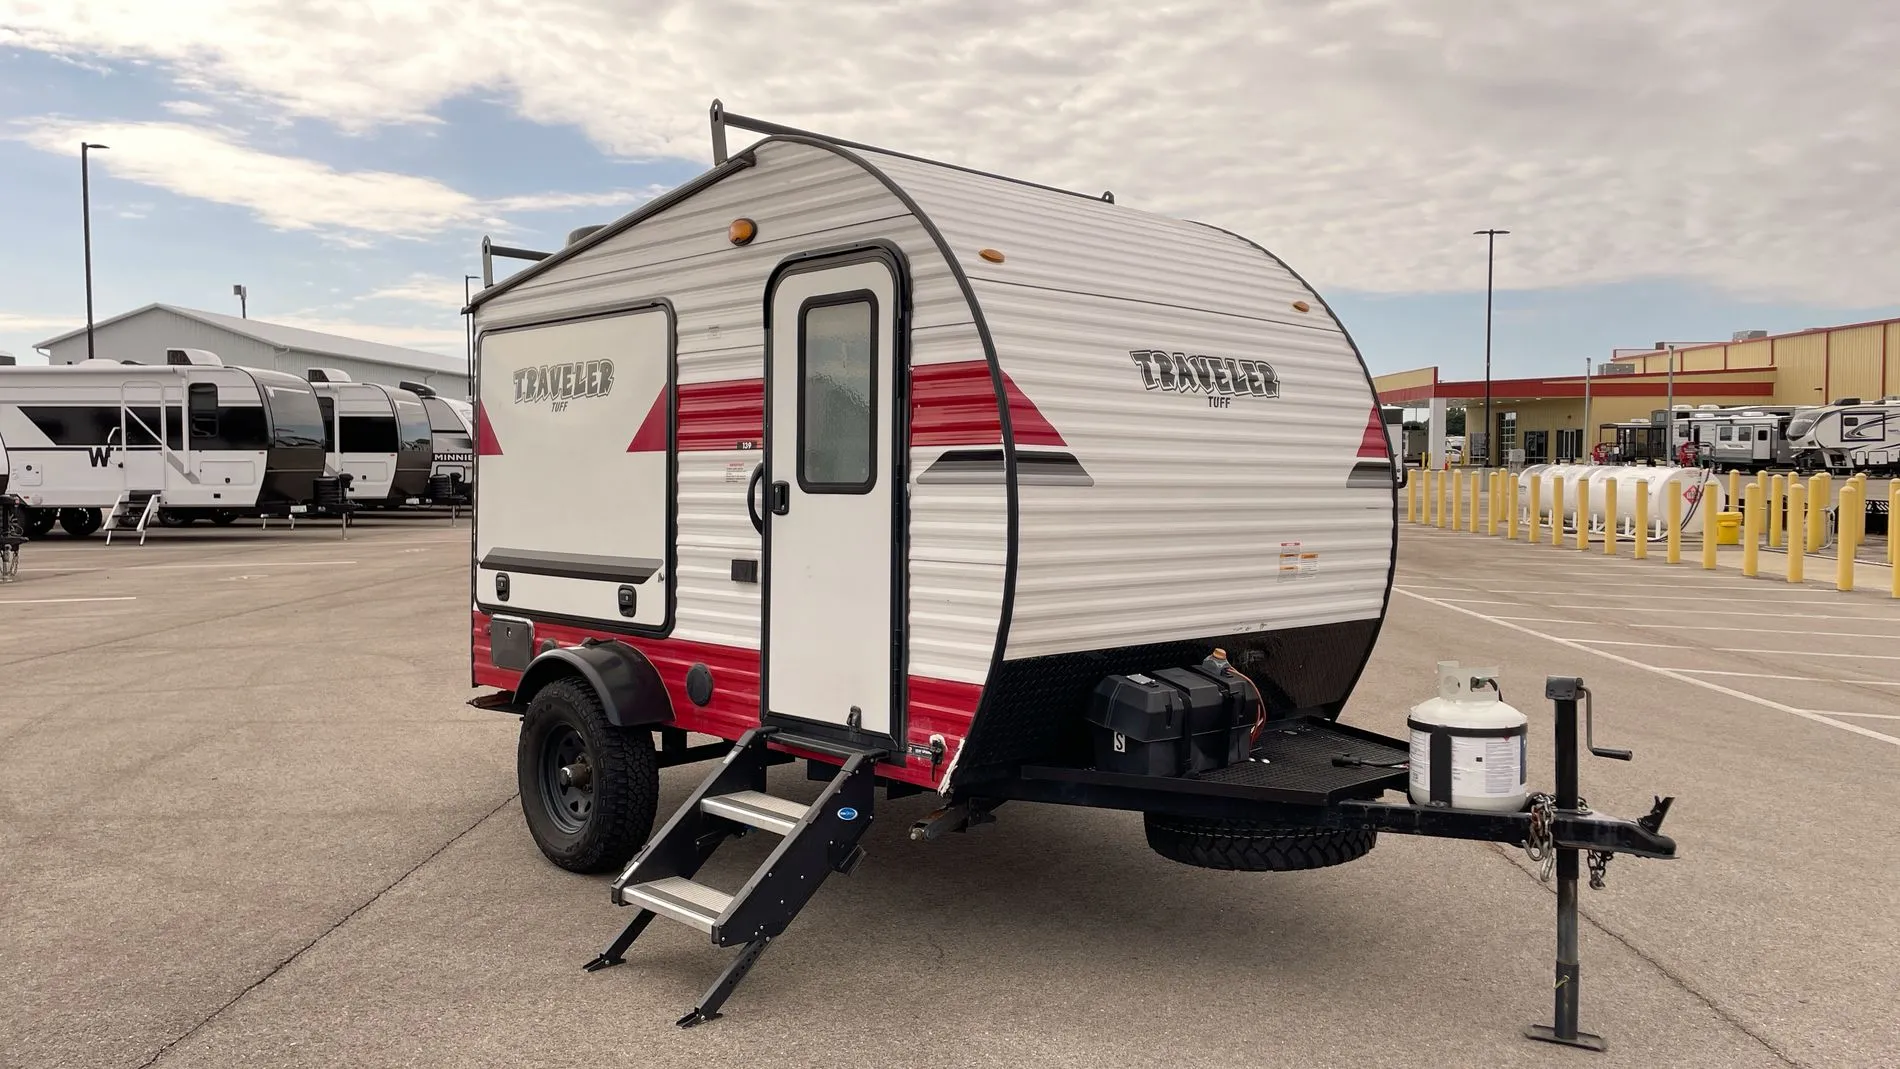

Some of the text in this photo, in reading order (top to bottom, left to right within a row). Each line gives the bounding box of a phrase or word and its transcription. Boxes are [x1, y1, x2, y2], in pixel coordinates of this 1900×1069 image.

[513, 359, 614, 404] TRAVELER
[1129, 350, 1280, 399] TRAVELER
[551, 401, 568, 412] TUFF
[1208, 396, 1231, 408] TUFF
[1116, 732, 1124, 750] S
